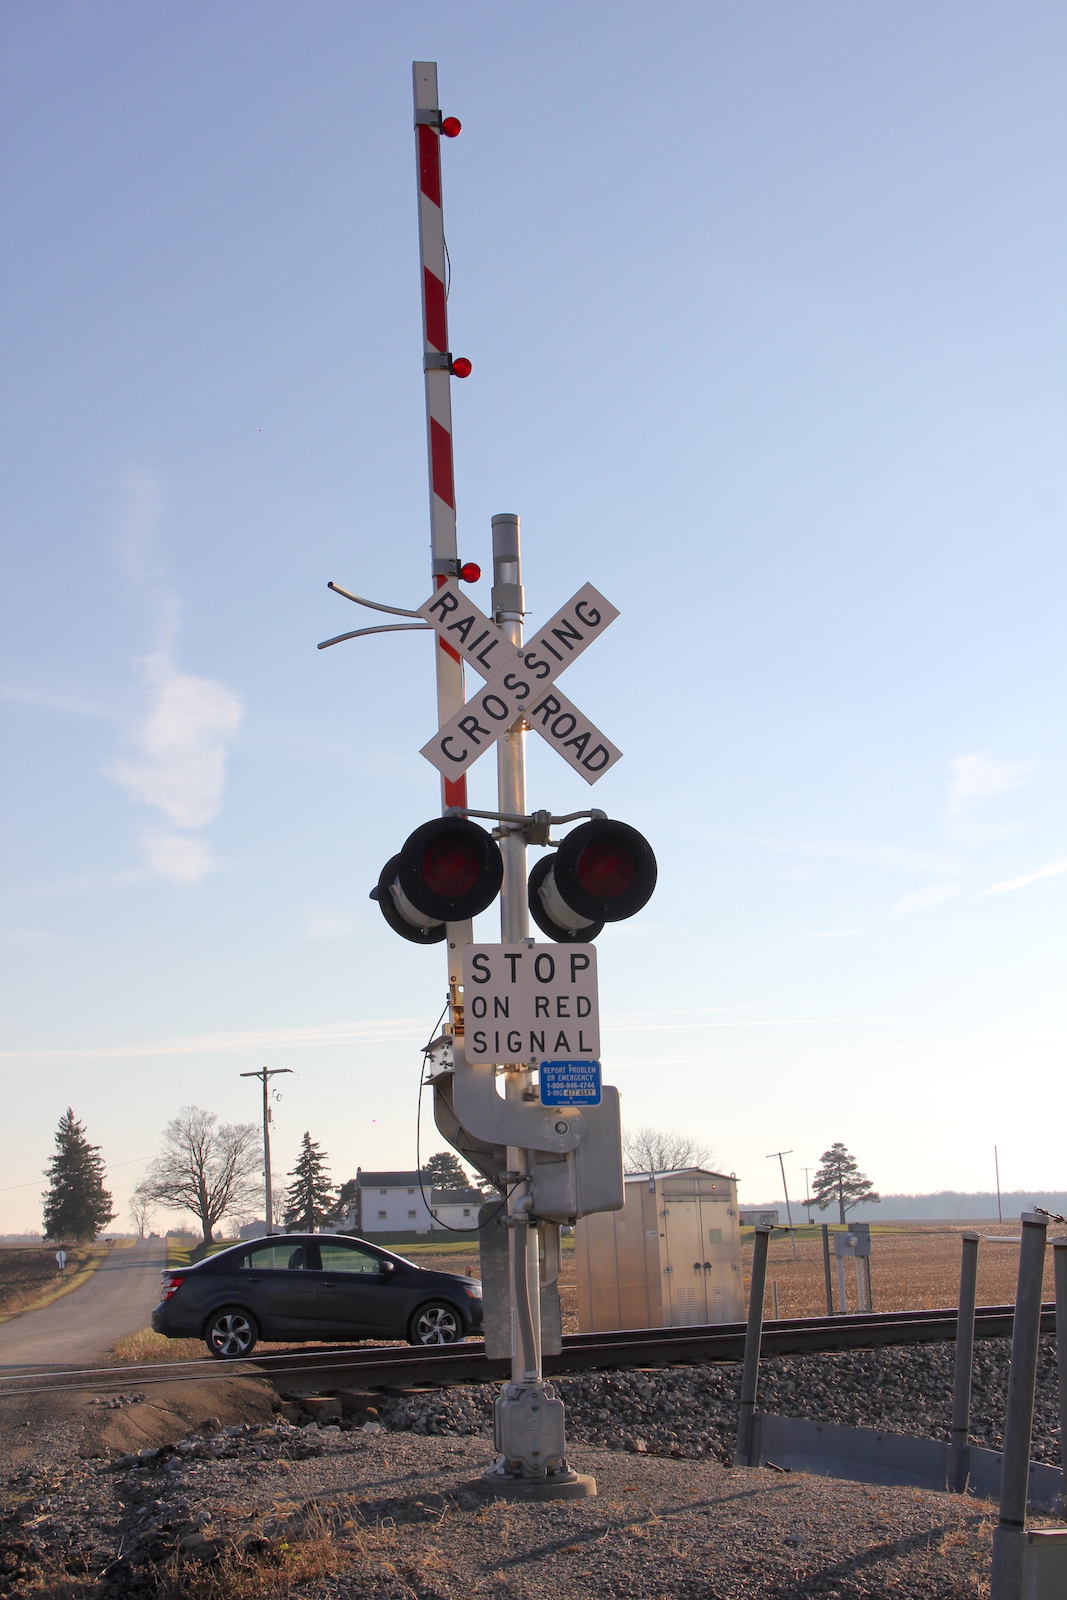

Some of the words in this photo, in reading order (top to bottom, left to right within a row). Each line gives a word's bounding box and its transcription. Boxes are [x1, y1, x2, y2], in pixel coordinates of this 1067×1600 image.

[428, 591, 499, 670] RAIL
[531, 694, 610, 772] ROAD
[440, 601, 602, 763] CROSSING
[472, 953, 590, 984] STOP
[472, 996, 510, 1019] ON
[535, 996, 592, 1018] RED
[473, 1031, 593, 1054] SIGNAL
